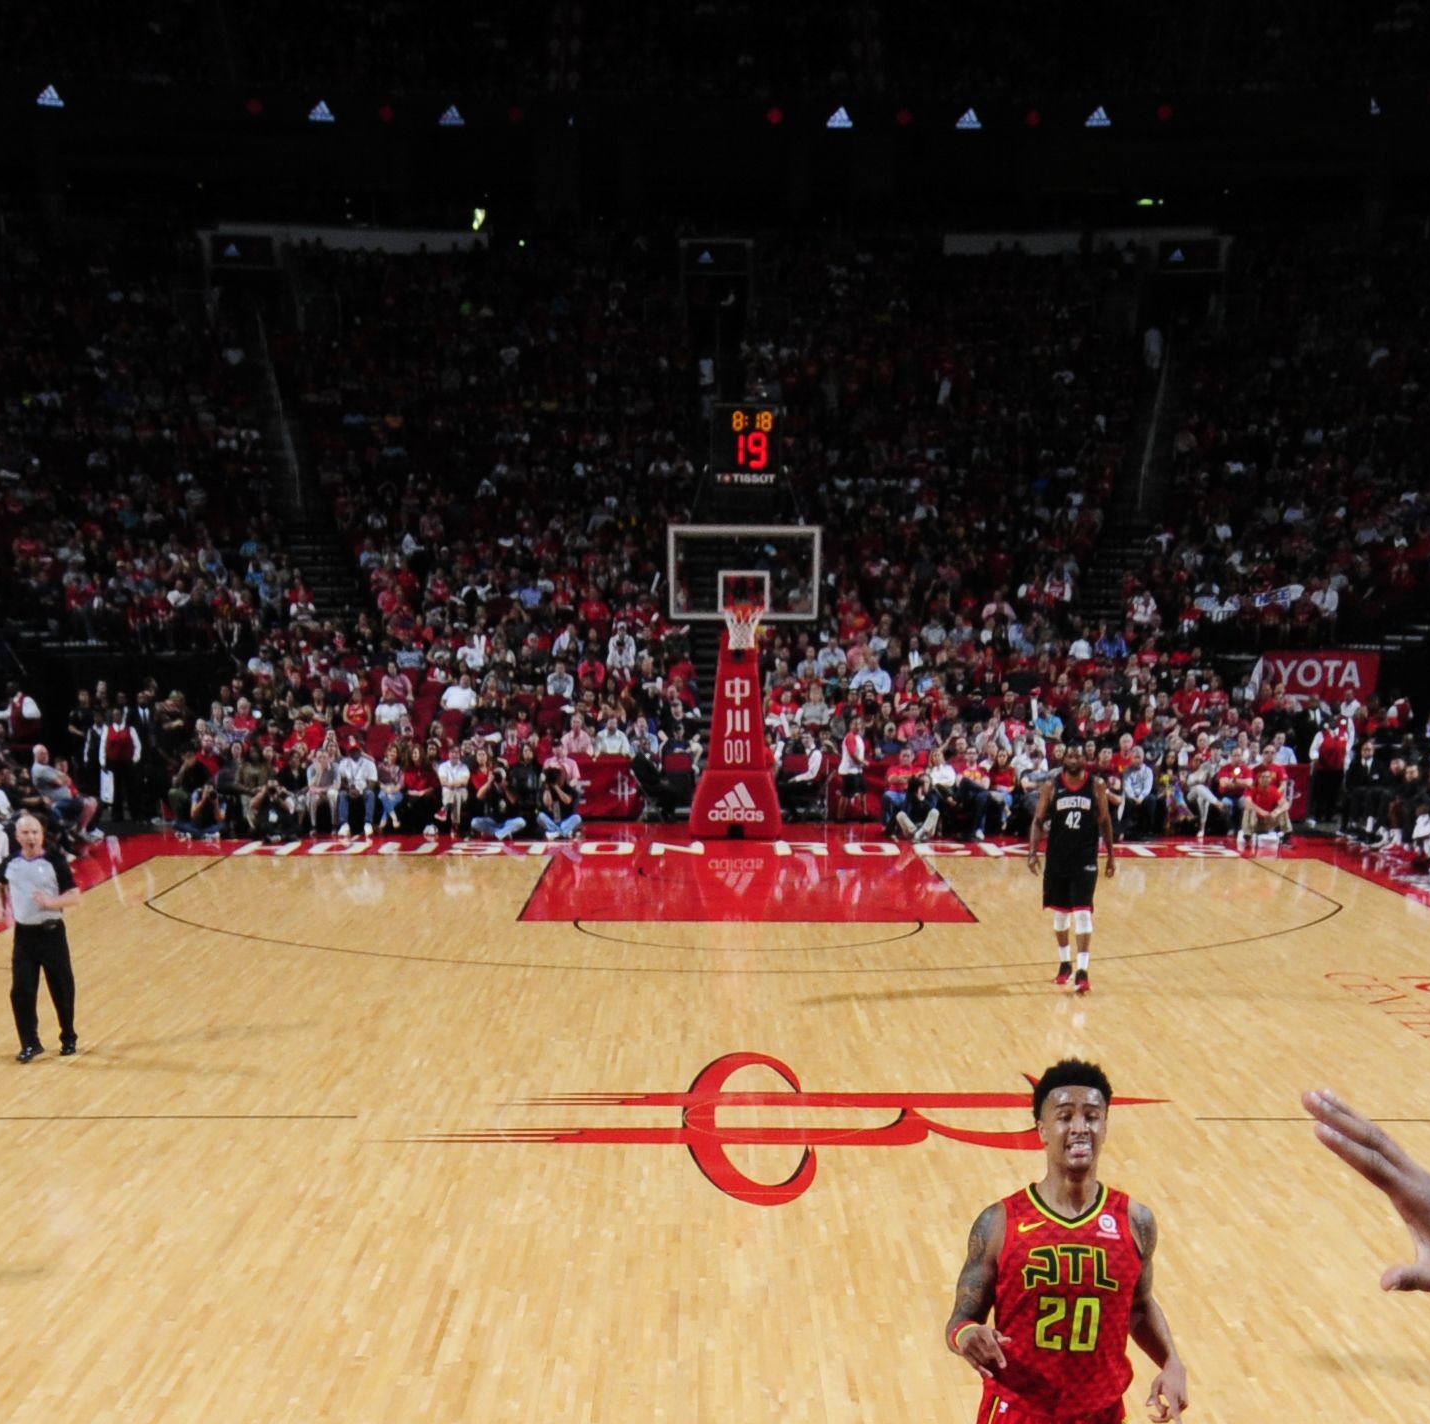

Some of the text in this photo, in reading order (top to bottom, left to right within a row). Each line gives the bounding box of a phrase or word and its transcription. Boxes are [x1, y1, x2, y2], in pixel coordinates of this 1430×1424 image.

[731, 410, 773, 433] 8:18
[737, 431, 768, 470] 19
[708, 808, 764, 822] adidas
[1065, 811, 1082, 829] 42
[233, 840, 1241, 857] HOUSTON ROCKTS
[1021, 1243, 1119, 1292] ATL
[1034, 1295, 1101, 1353] 20
